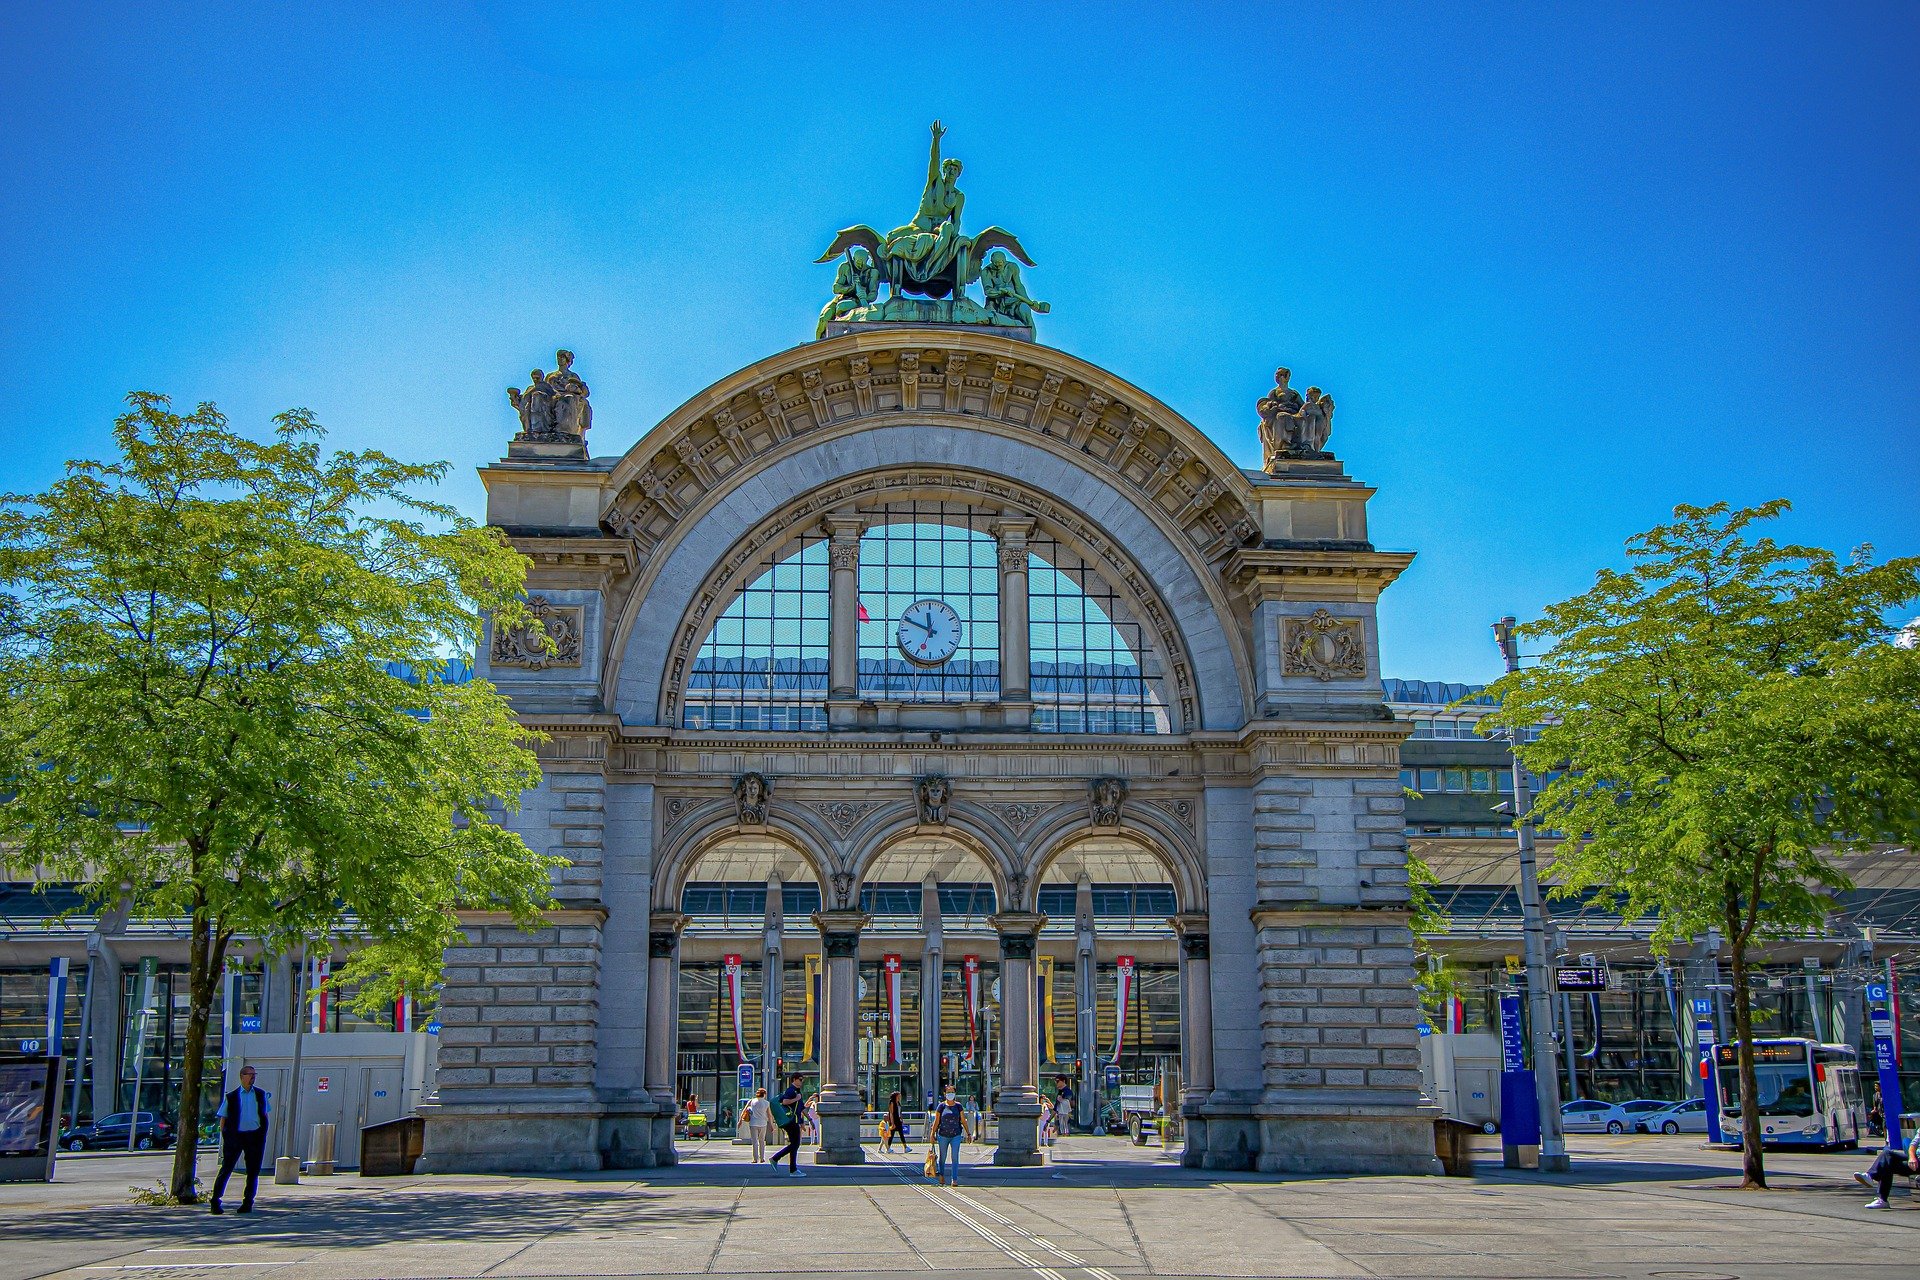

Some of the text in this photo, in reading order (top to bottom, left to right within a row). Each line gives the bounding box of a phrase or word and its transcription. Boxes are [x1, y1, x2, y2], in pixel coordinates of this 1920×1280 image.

[1872, 987, 1883, 998] G
[1697, 1001, 1706, 1012] H
[862, 1012, 879, 1021] CFF
[1876, 1043, 1888, 1051] 14
